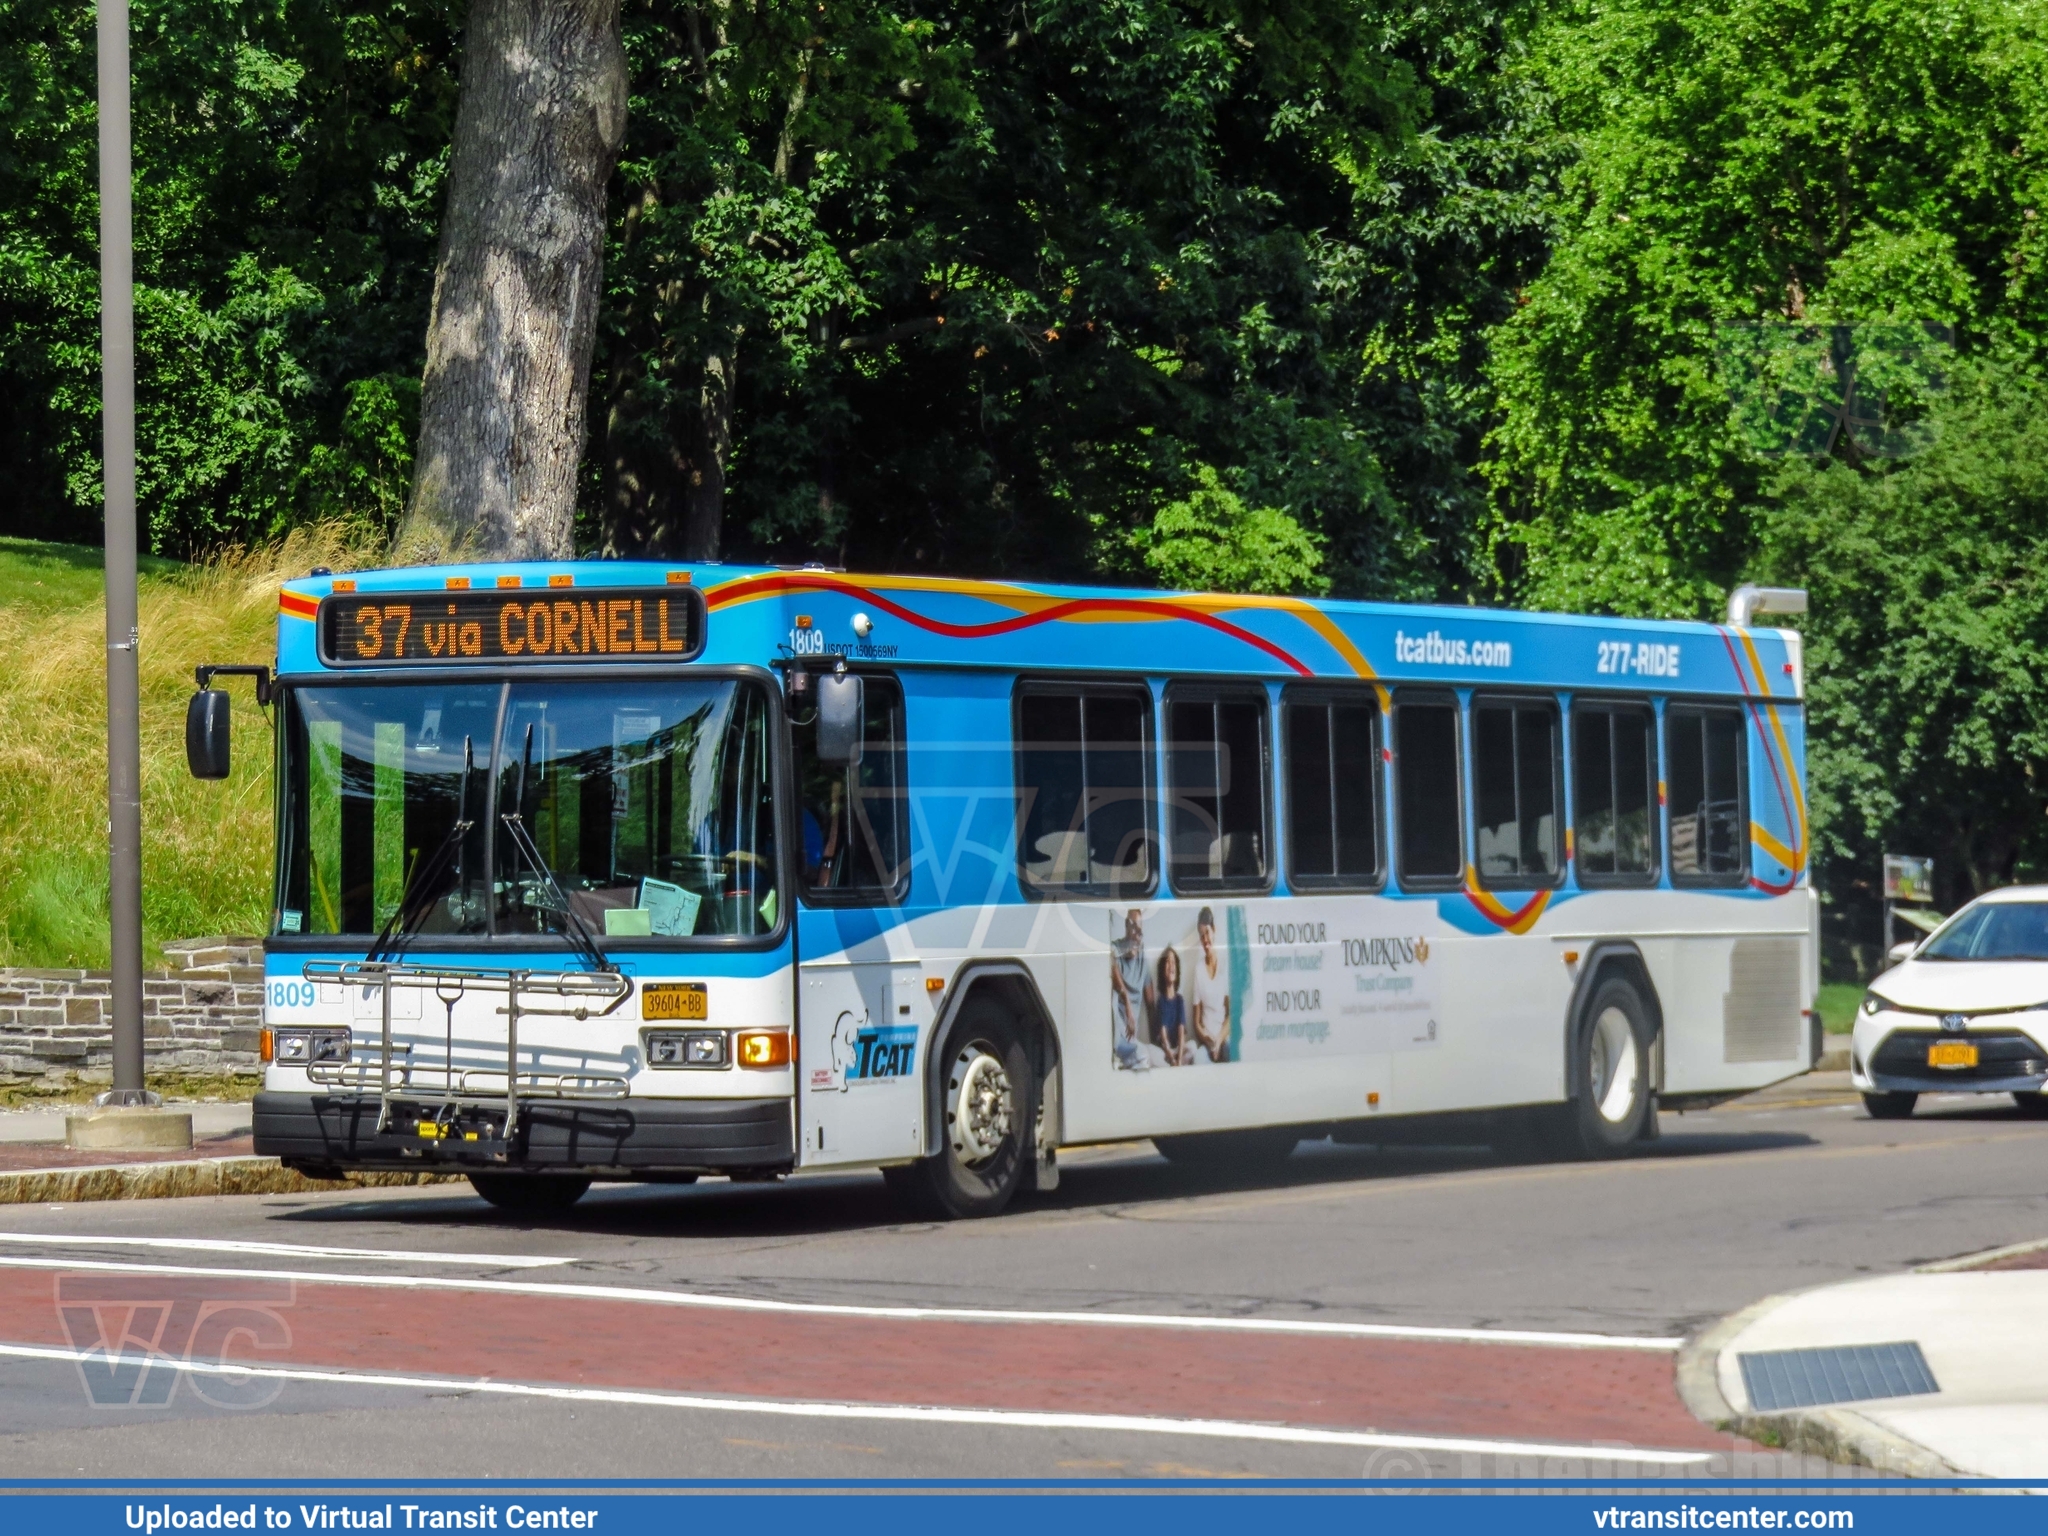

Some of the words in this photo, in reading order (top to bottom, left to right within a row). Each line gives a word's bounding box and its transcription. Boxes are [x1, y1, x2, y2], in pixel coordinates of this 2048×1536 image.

[356, 605, 412, 658] 37
[424, 604, 481, 657] via
[500, 599, 684, 655] CORNELL
[789, 628, 823, 654] 1809
[1395, 630, 1512, 667] tcatbus.com
[1597, 640, 1680, 677] 277-RIDE
[1258, 923, 1295, 945] FOUND
[1297, 922, 1327, 943] YOUR
[1341, 936, 1414, 971] TOMPKINS
[267, 982, 315, 1007] 1809
[1266, 991, 1290, 1012] FIND
[1292, 989, 1321, 1010] YOUR
[858, 1034, 914, 1079] TCAT
